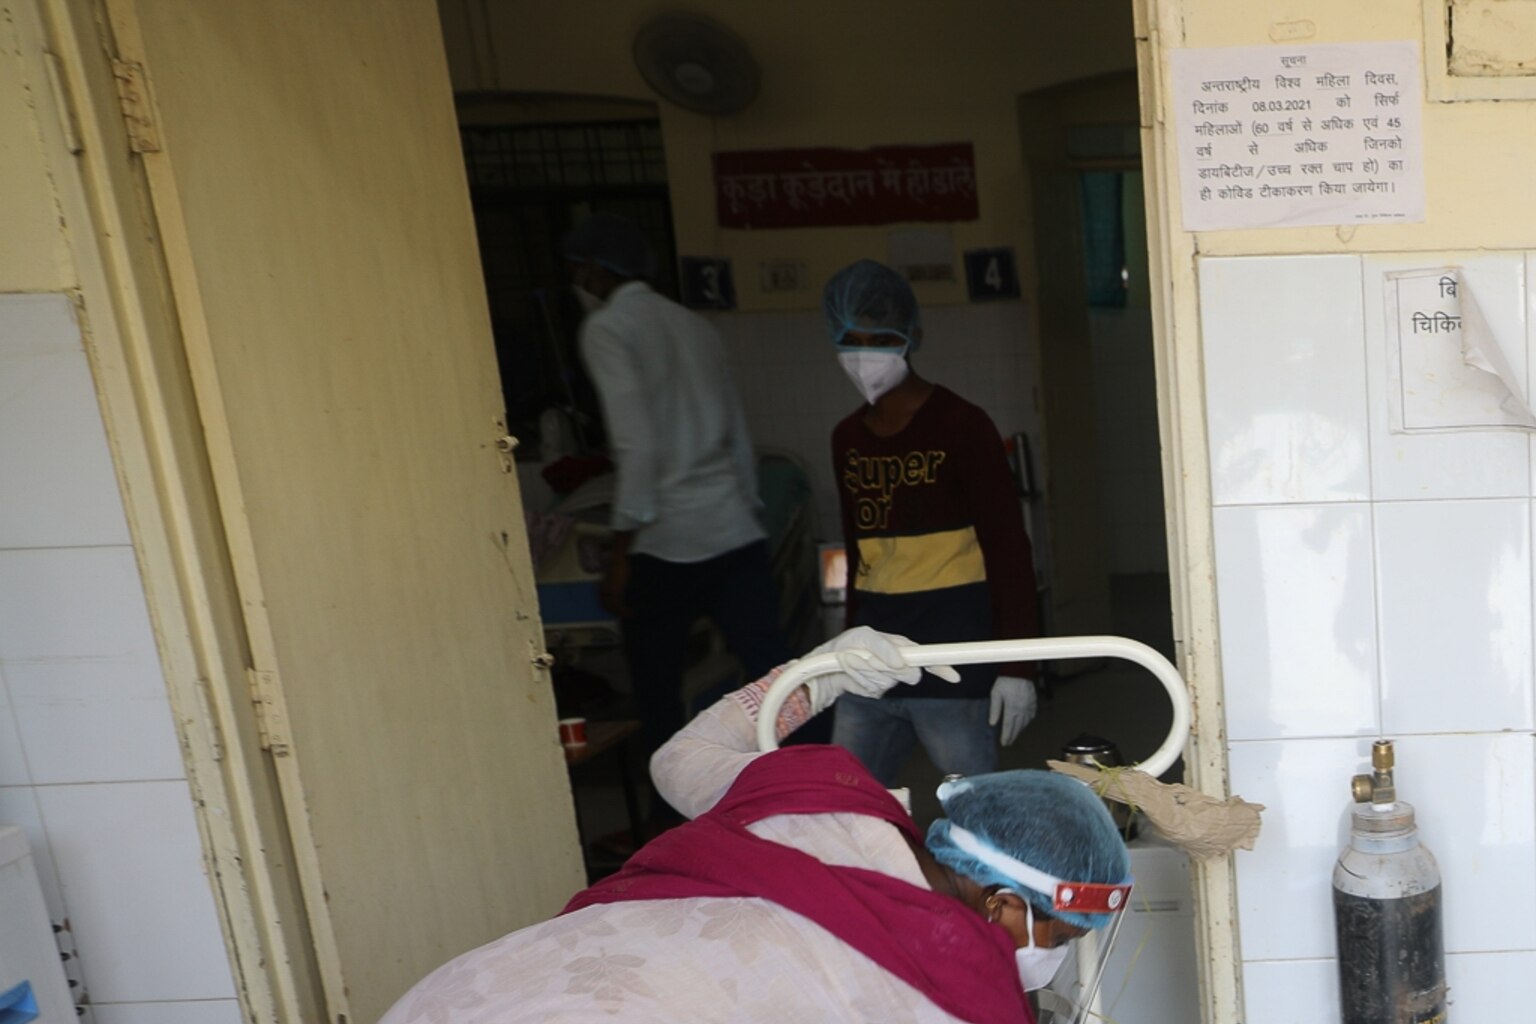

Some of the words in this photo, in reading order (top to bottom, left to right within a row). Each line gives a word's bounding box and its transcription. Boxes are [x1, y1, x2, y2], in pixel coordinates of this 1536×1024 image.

[1280, 55, 1307, 68] सूचना
[1201, 76, 1261, 93] अन्तराष्ट्रीय
[1275, 74, 1302, 88] विश्व
[1315, 72, 1350, 88] महिला
[1192, 100, 1229, 114] दिनांक
[1252, 100, 1311, 112] 08.03.2021
[1336, 93, 1351, 108] को
[1374, 91, 1400, 106] सिर्फ
[1251, 119, 1269, 136] (60
[1277, 118, 1293, 132] वर्ष
[1302, 116, 1312, 131] से
[1321, 116, 1354, 130] अधिक
[1362, 115, 1378, 130] एवं
[1387, 118, 1401, 128] 45
[1196, 143, 1212, 157] वर्ष
[1248, 140, 1259, 155] से
[1294, 139, 1328, 153] अधिक
[1364, 134, 1402, 151] जिनको
[1301, 162, 1323, 174] रक्त
[1333, 162, 1353, 173] चाप
[1362, 157, 1379, 174] हो)
[1388, 159, 1404, 171] का
[1200, 185, 1211, 201] ही
[1218, 185, 1254, 200] कोविड
[1259, 183, 1313, 198] टीकाकरण
[1320, 181, 1346, 195] किया
[700, 265, 719, 300] 3
[983, 255, 1002, 293] 4
